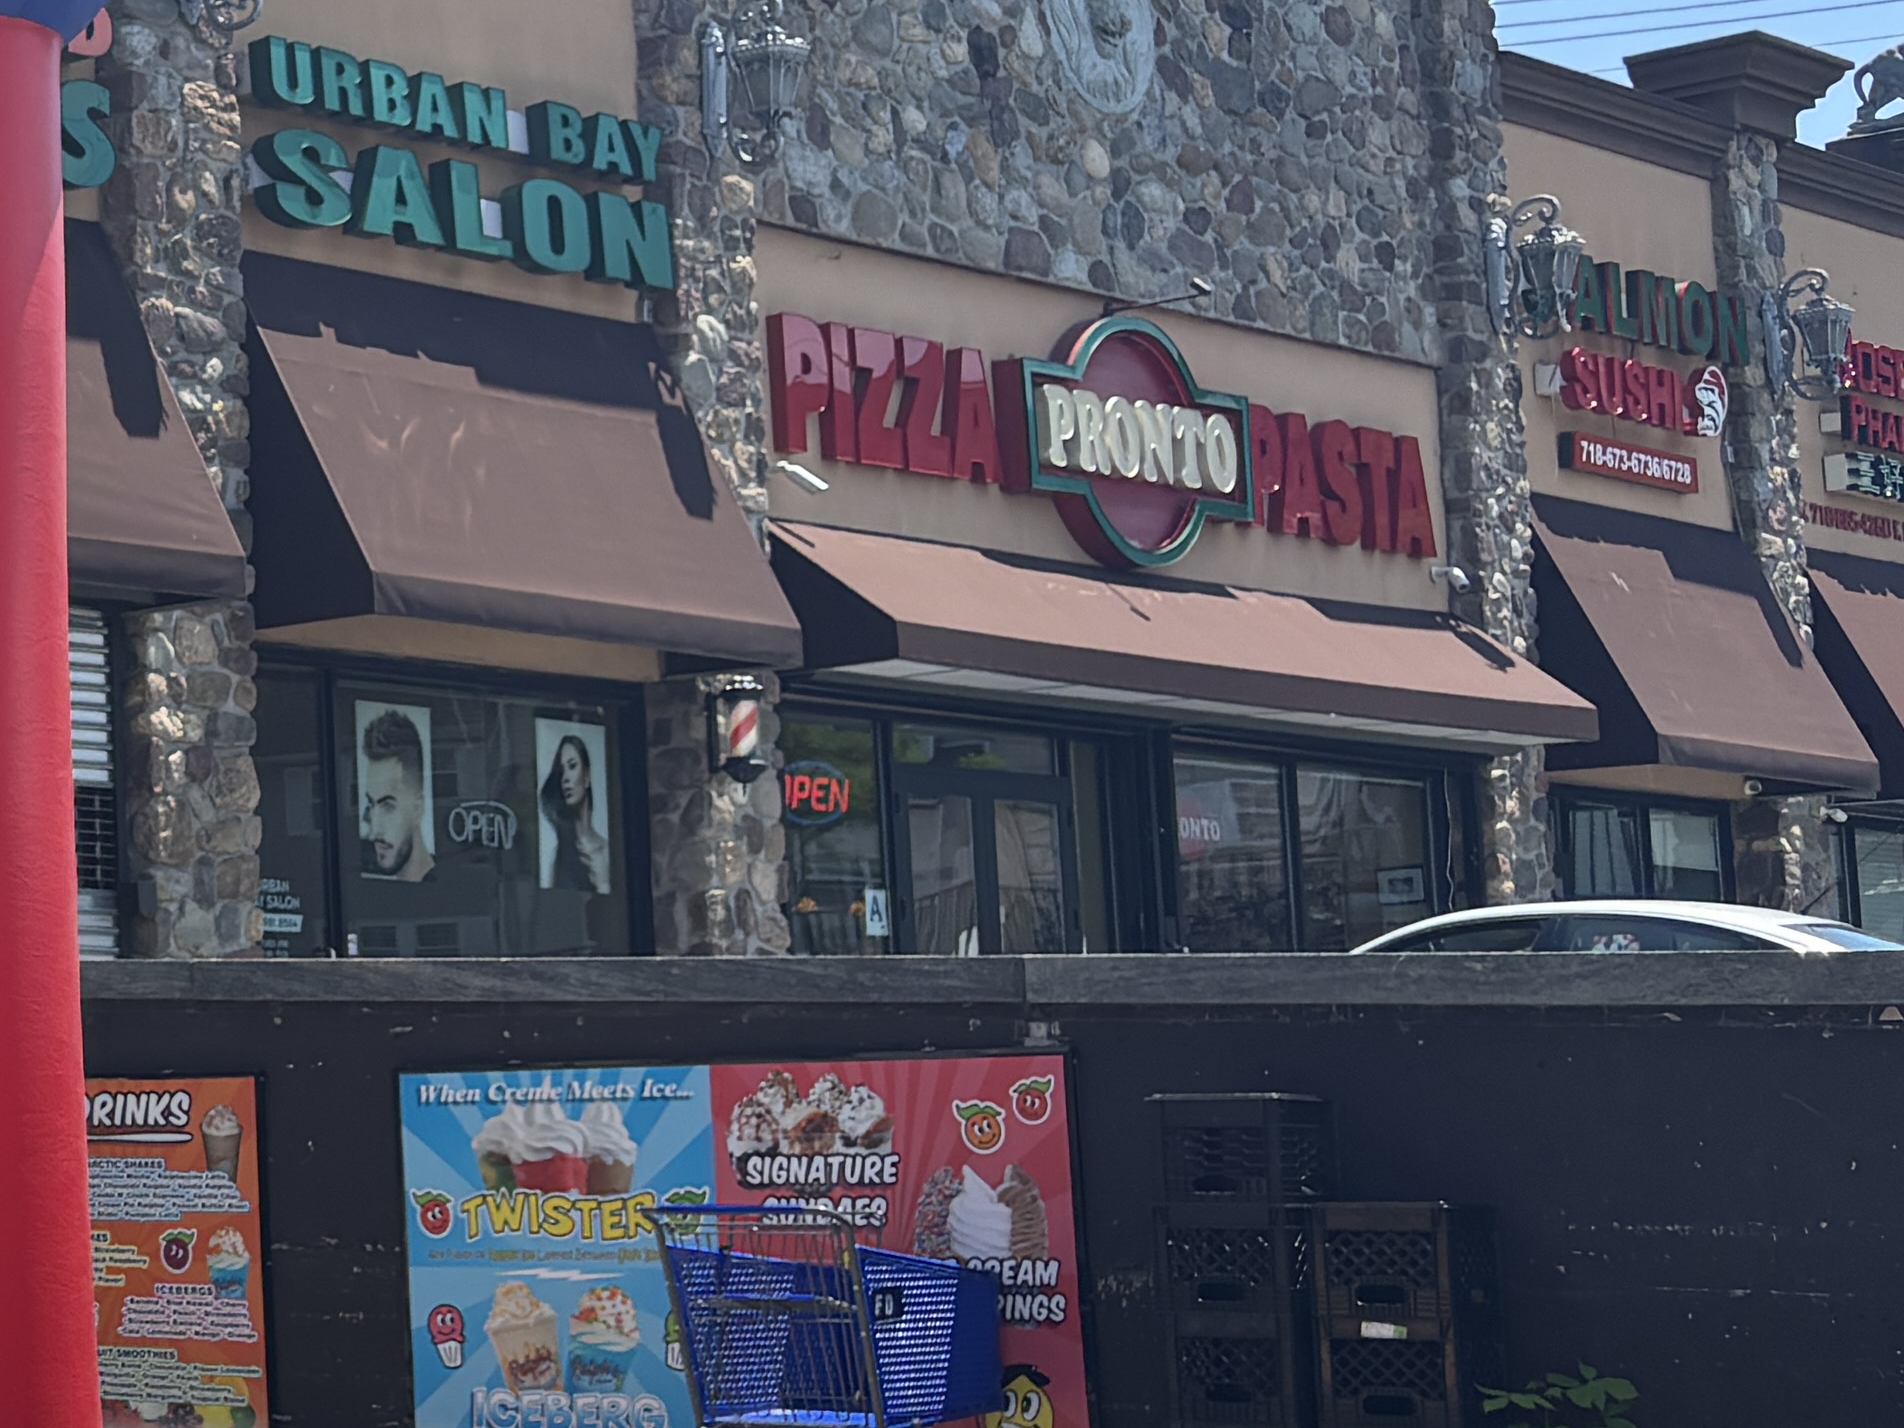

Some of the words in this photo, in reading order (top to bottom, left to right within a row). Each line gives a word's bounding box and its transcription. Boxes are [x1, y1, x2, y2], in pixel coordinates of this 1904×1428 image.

[254, 36, 510, 150] URBAN
[537, 100, 664, 183] BAY
[260, 128, 675, 290] SALON
[1566, 347, 1685, 430] SUSHI
[767, 312, 1002, 484] PIZZA
[1043, 382, 1239, 493] PRONTO
[1250, 403, 1438, 558] PASTA
[449, 807, 513, 850] OPEN
[869, 895, 884, 923] A
[418, 1083, 481, 1104] When
[568, 1080, 635, 1102] Meets
[641, 1078, 695, 1099] Ice...
[745, 1154, 900, 1186] SIGNATURE
[461, 1192, 657, 1242] TWISTER
